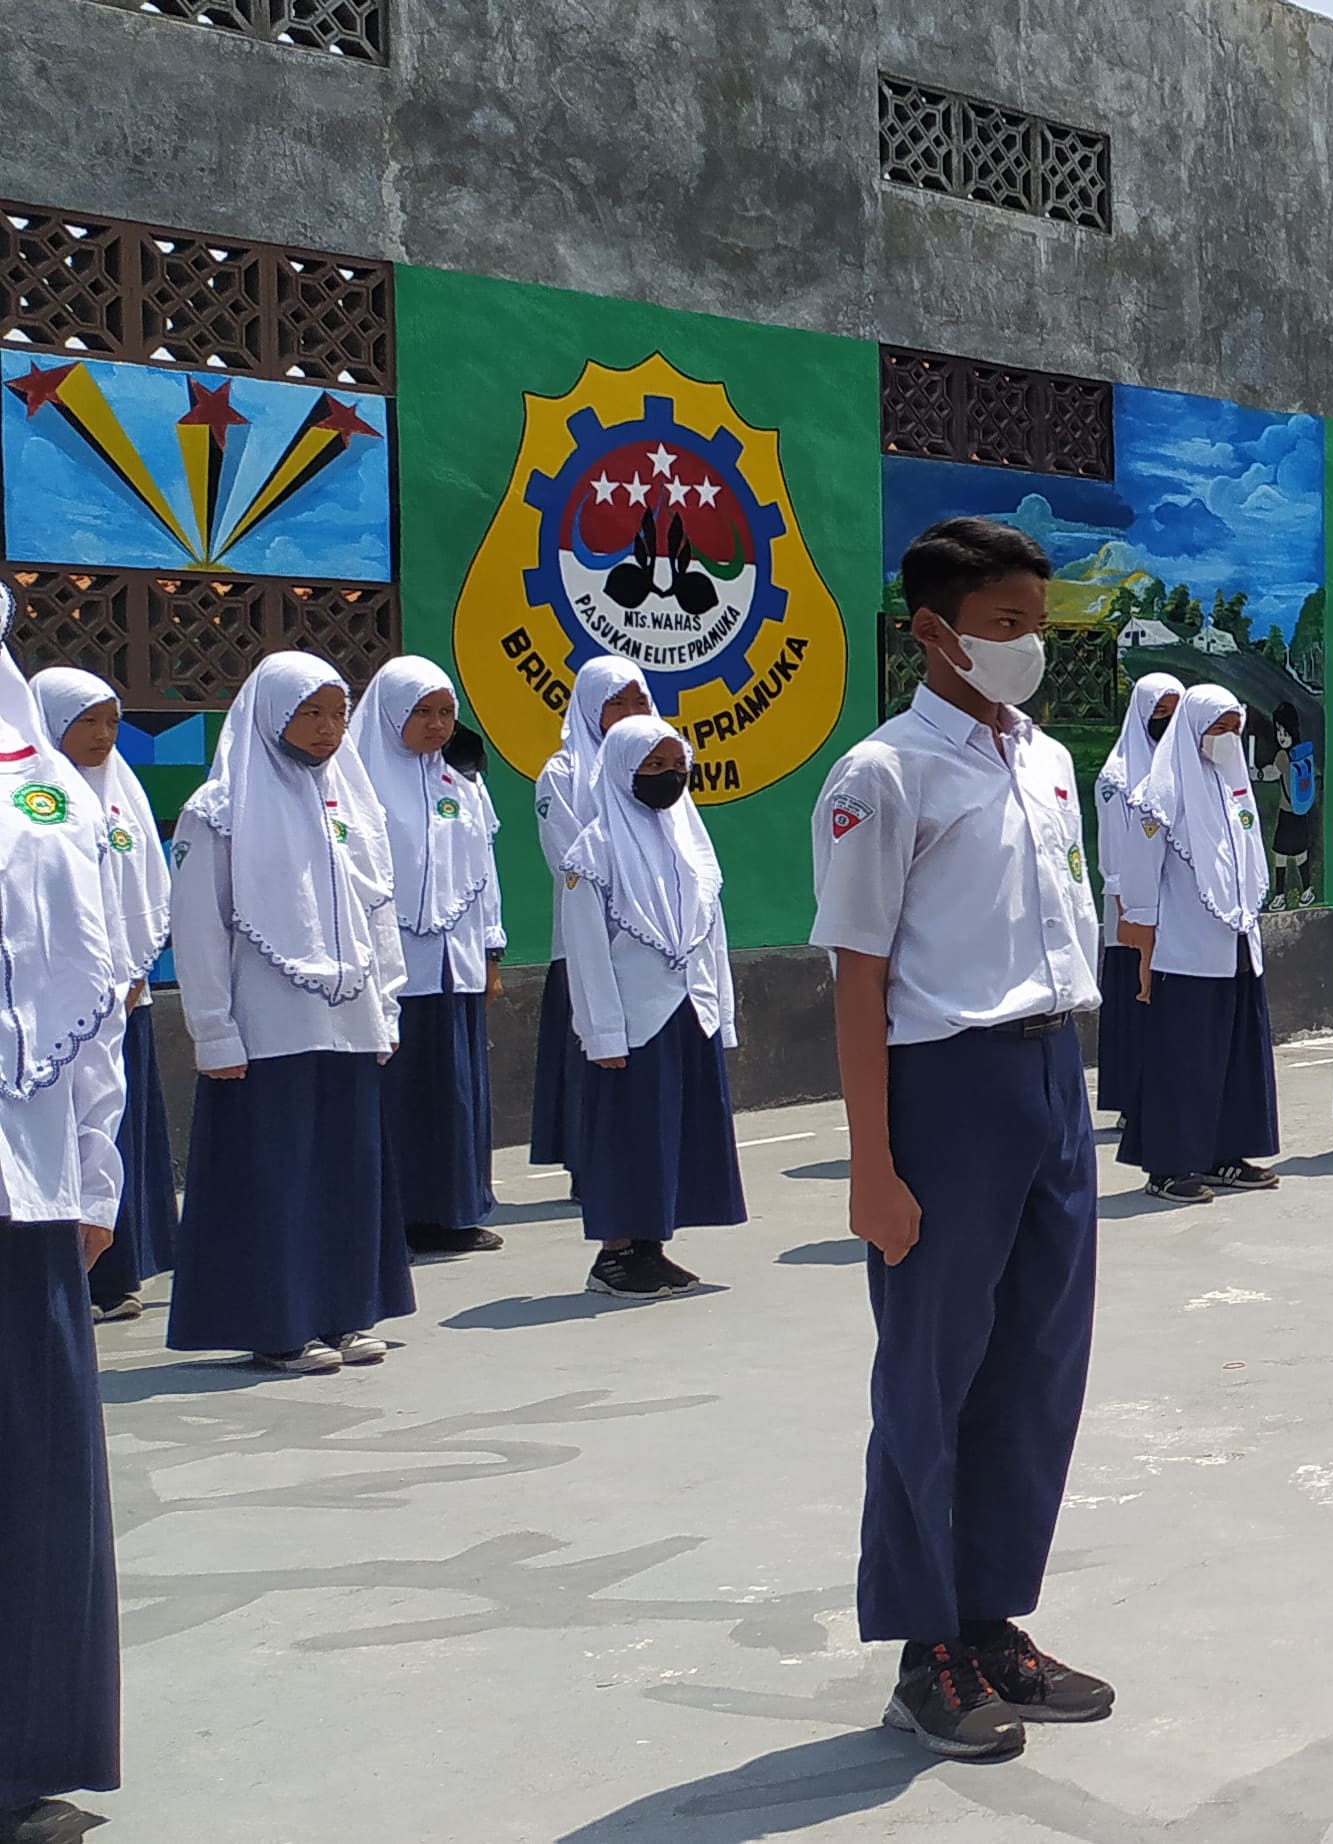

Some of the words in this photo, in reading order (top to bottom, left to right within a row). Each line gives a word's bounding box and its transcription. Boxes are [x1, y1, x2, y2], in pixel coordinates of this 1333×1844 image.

[575, 593, 642, 659] PASUKAN
[644, 645, 686, 664] ELITE
[688, 605, 741, 661] PRAMUKA
[500, 626, 568, 718] BRIG
[693, 637, 809, 749] PRAMUKA
[689, 760, 740, 792] AYA
